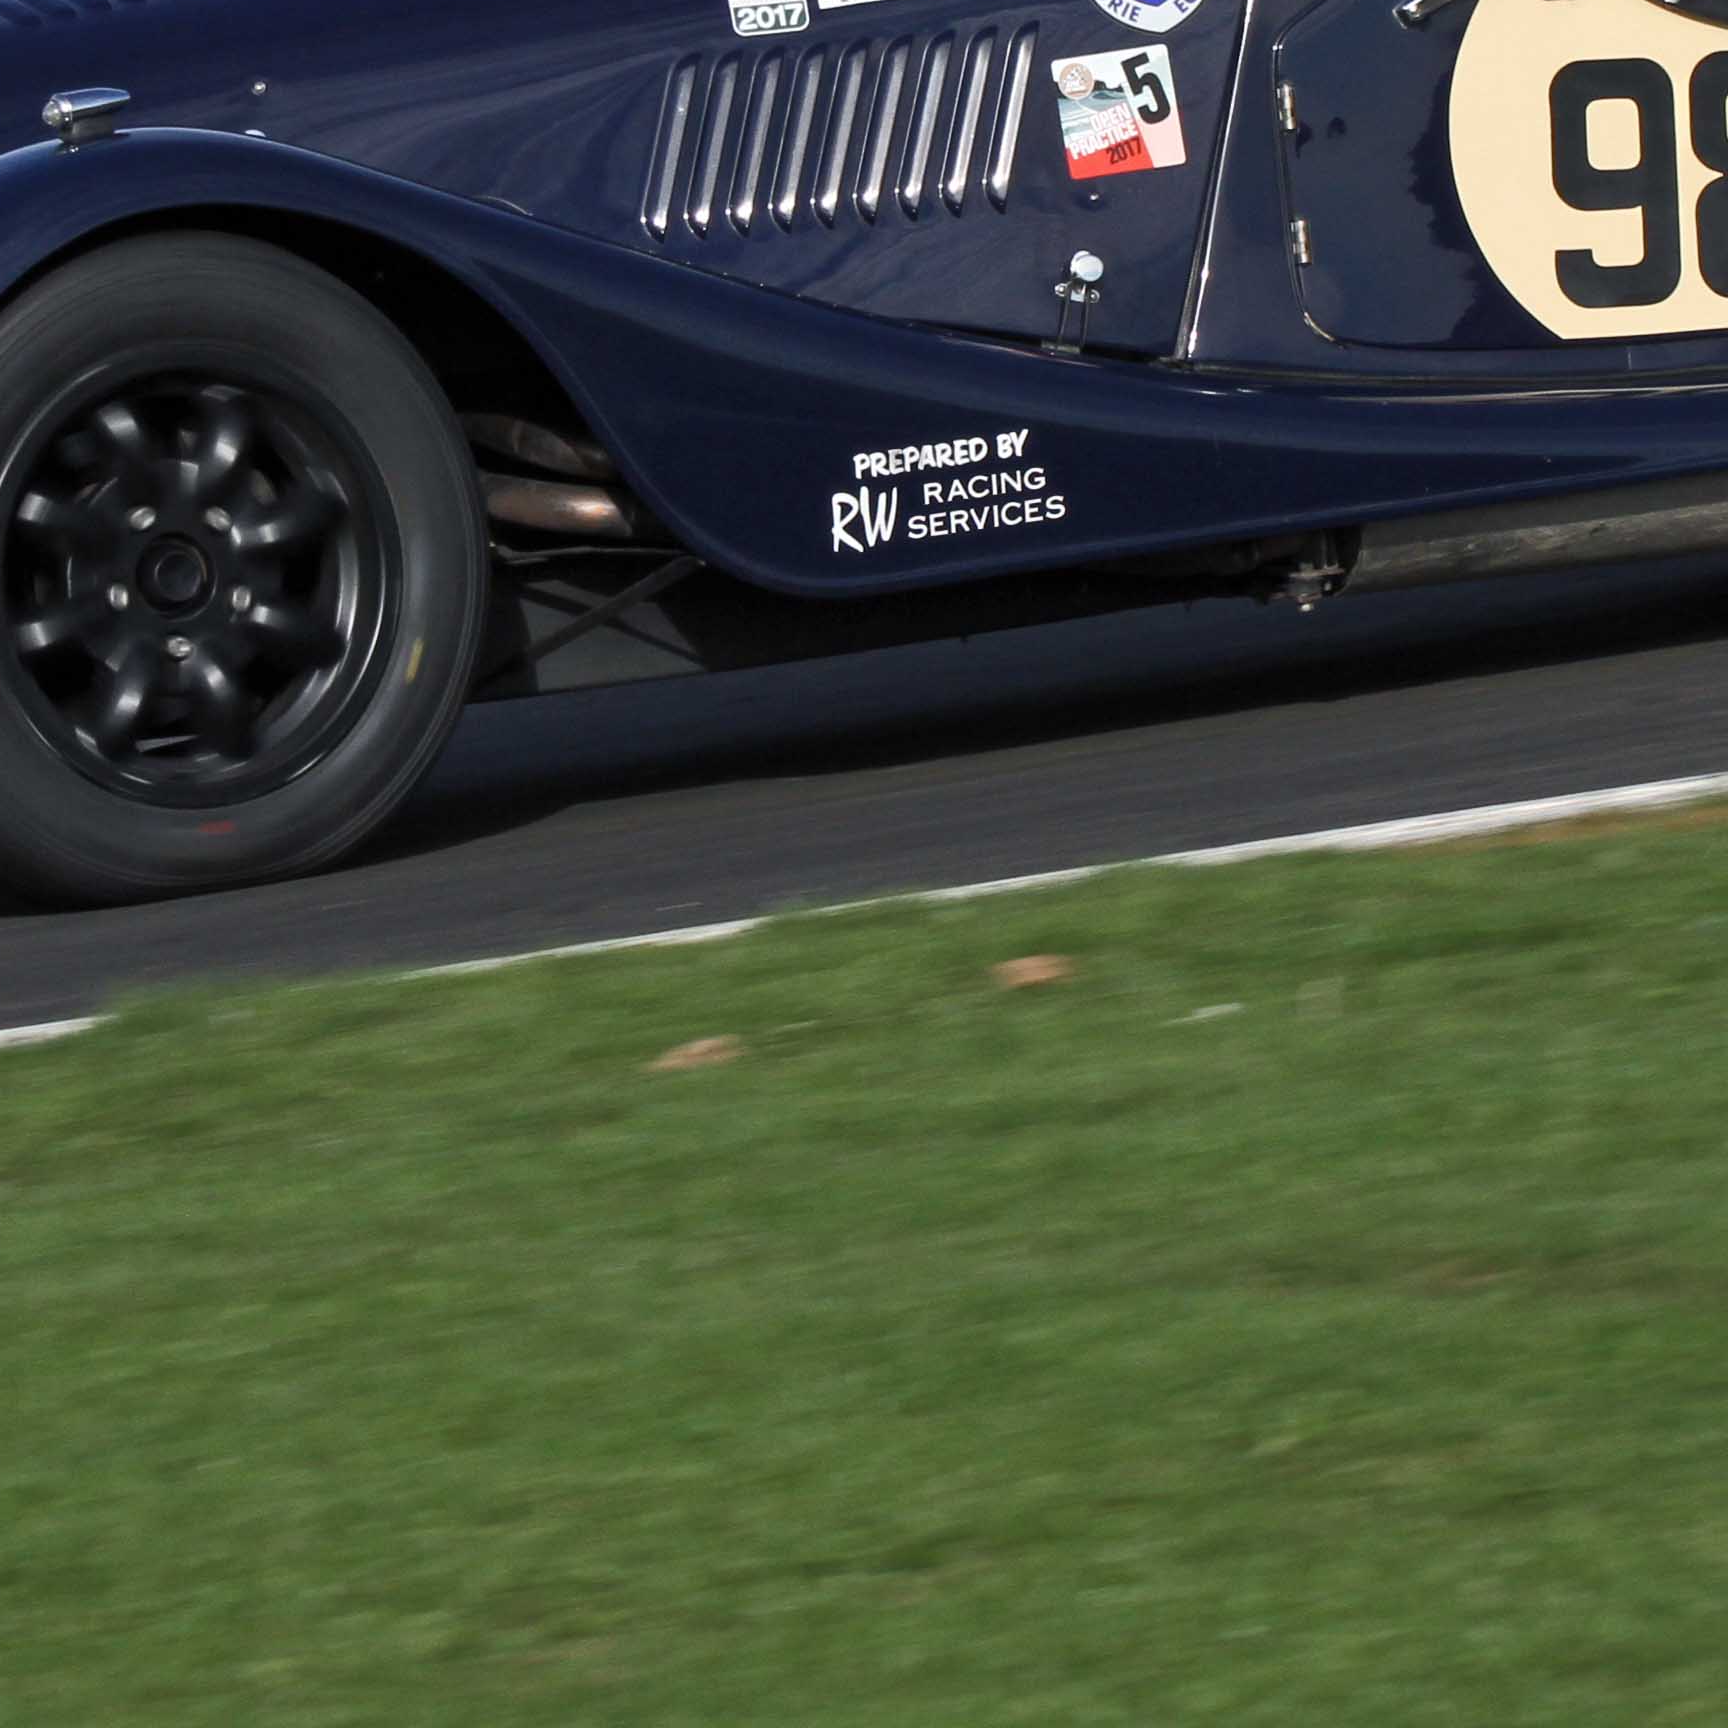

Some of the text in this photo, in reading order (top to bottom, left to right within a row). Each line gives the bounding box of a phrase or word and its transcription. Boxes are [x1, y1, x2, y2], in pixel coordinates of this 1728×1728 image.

[737, 4, 804, 32] 2017
[1120, 52, 1171, 125] 5
[1089, 102, 1132, 132] OPEN
[1069, 122, 1139, 160] PRACTICE
[1106, 137, 1142, 164] 2017
[853, 428, 1029, 480] PREPARED BY
[923, 467, 1047, 505] RACING
[831, 485, 898, 553] RW
[907, 495, 1067, 540] SERVICES
